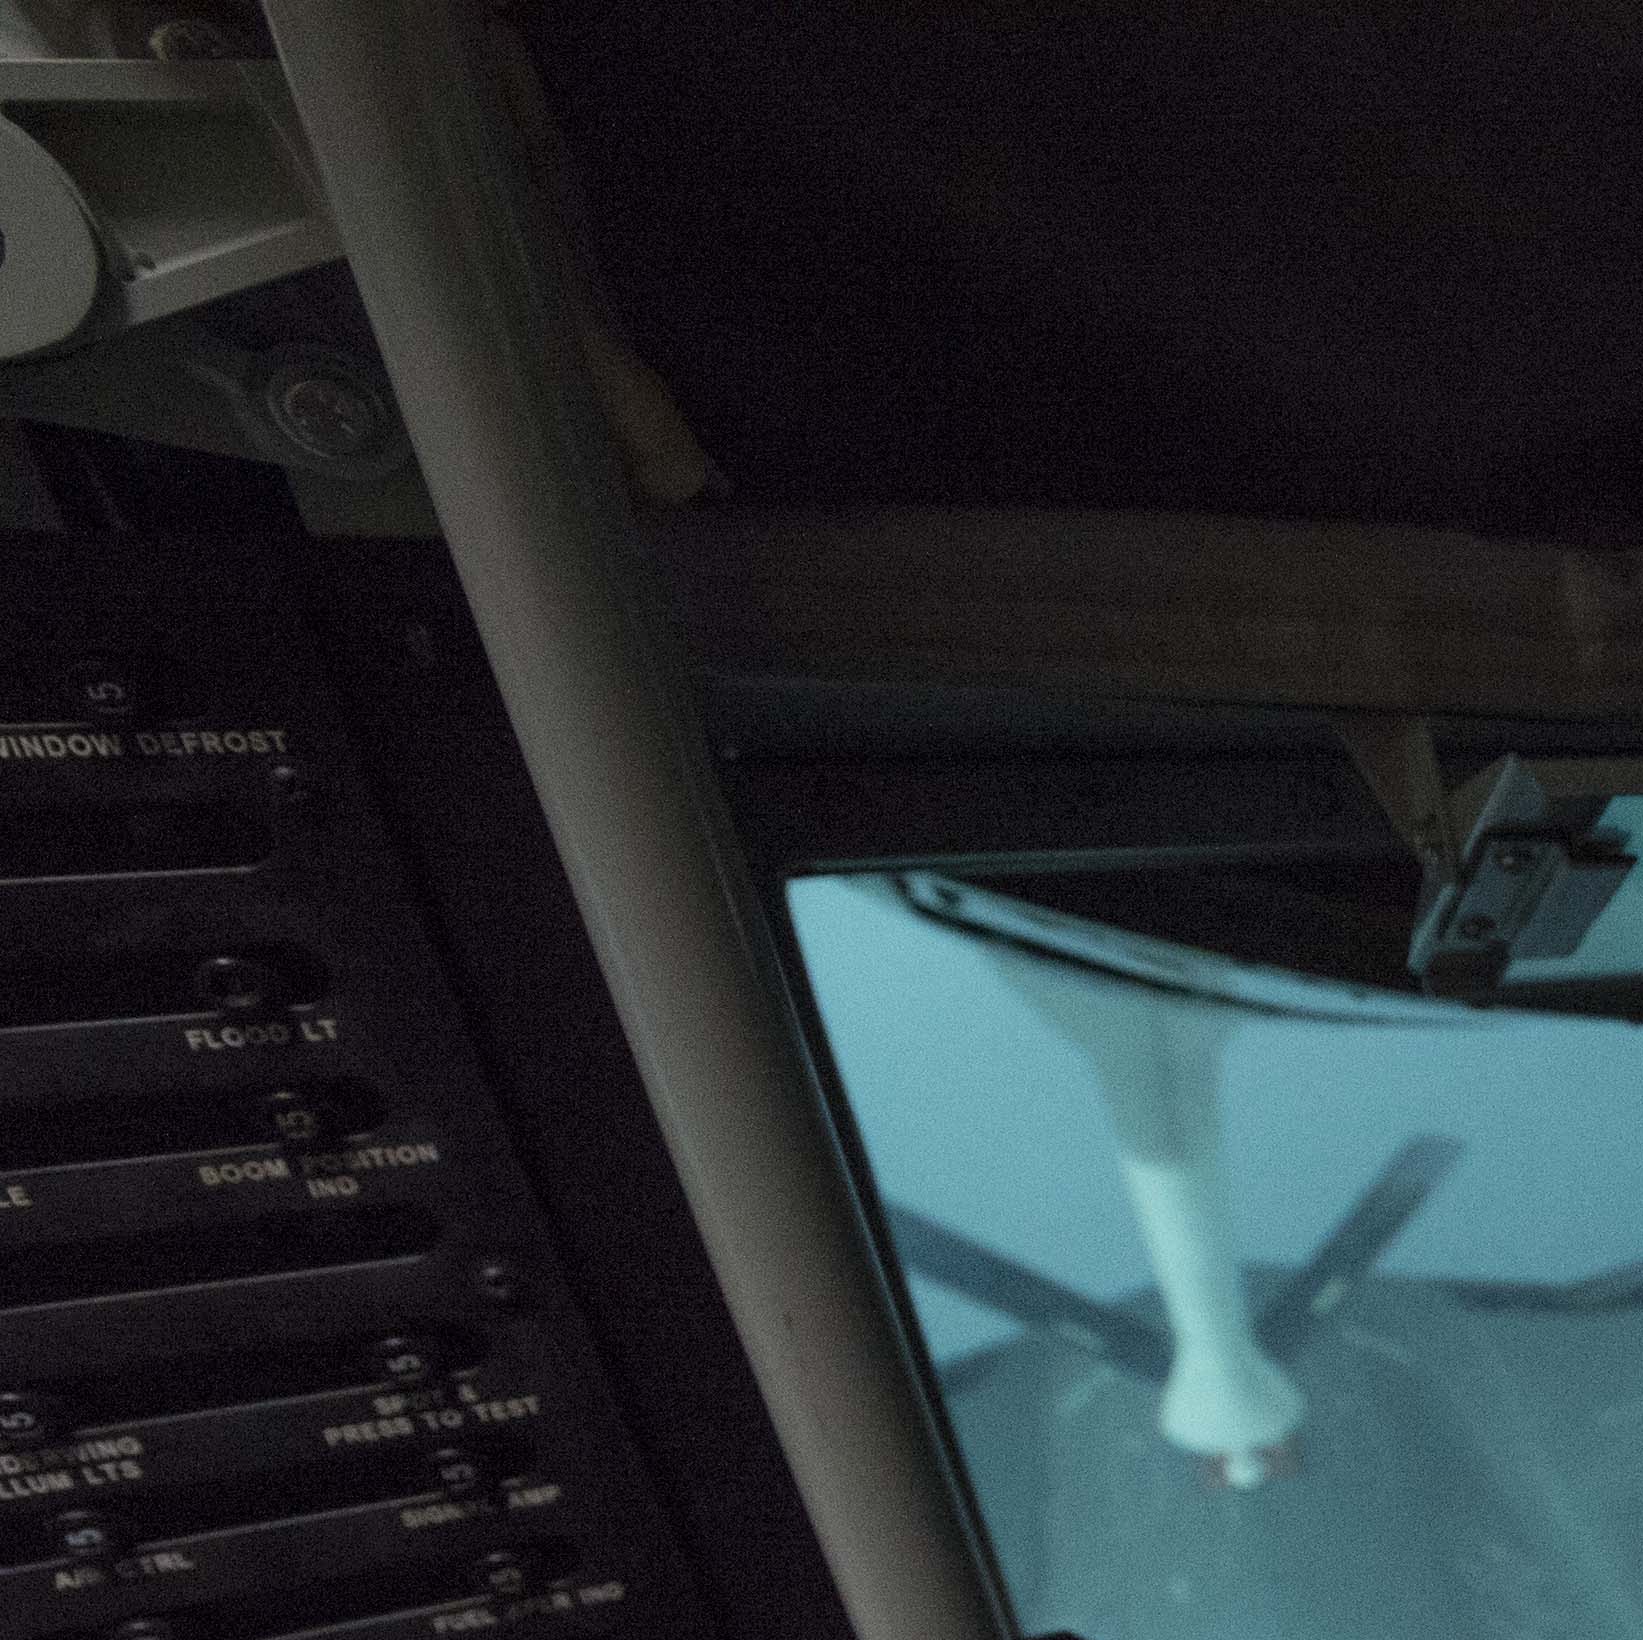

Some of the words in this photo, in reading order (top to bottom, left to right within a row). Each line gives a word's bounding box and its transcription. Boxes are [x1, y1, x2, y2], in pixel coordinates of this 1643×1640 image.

[136, 729, 288, 758] DEFROST
[184, 1022, 290, 1051] FLOOD
[301, 1018, 338, 1043] LT
[199, 1157, 290, 1187] BOOM
[323, 1415, 414, 1448] PRESS
[420, 1407, 464, 1432] TO
[472, 1395, 541, 1422] TEST
[81, 1459, 145, 1486] LTS
